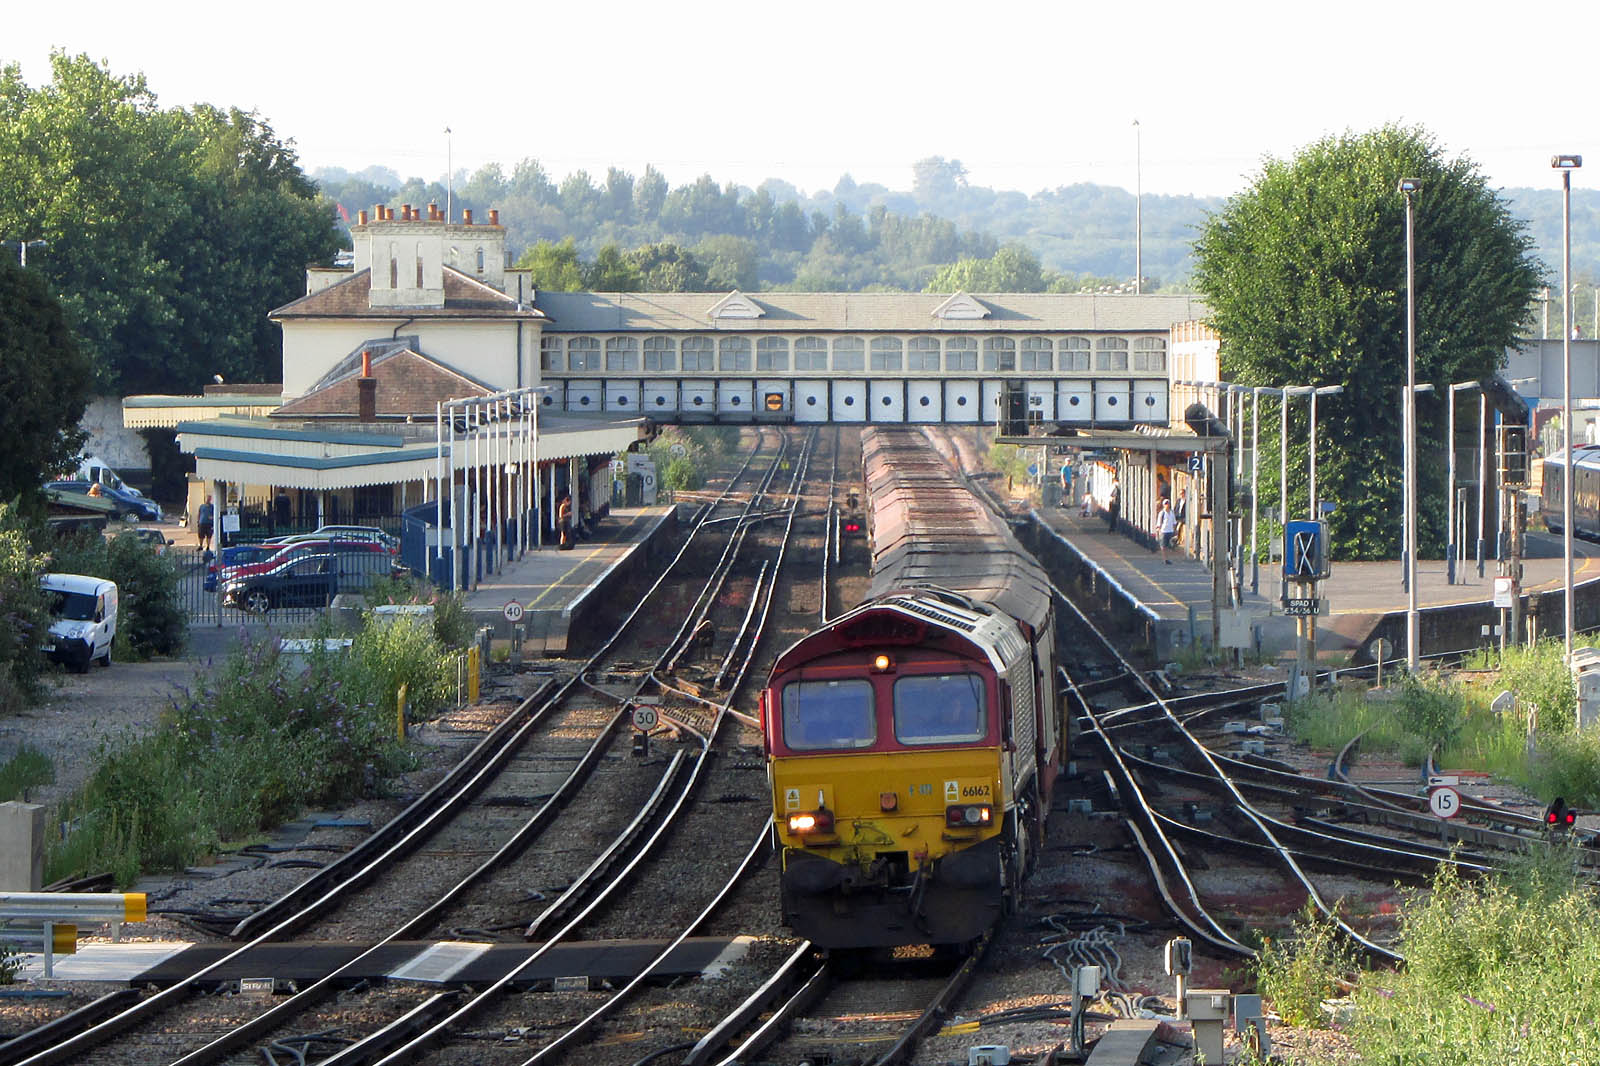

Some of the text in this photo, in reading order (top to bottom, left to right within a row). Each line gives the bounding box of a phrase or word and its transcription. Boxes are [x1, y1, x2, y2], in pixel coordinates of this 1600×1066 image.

[1191, 457, 1200, 470] 2
[506, 606, 521, 617] 40
[636, 711, 654, 725] 30
[962, 785, 990, 797] 66162
[1438, 794, 1451, 809] 15
